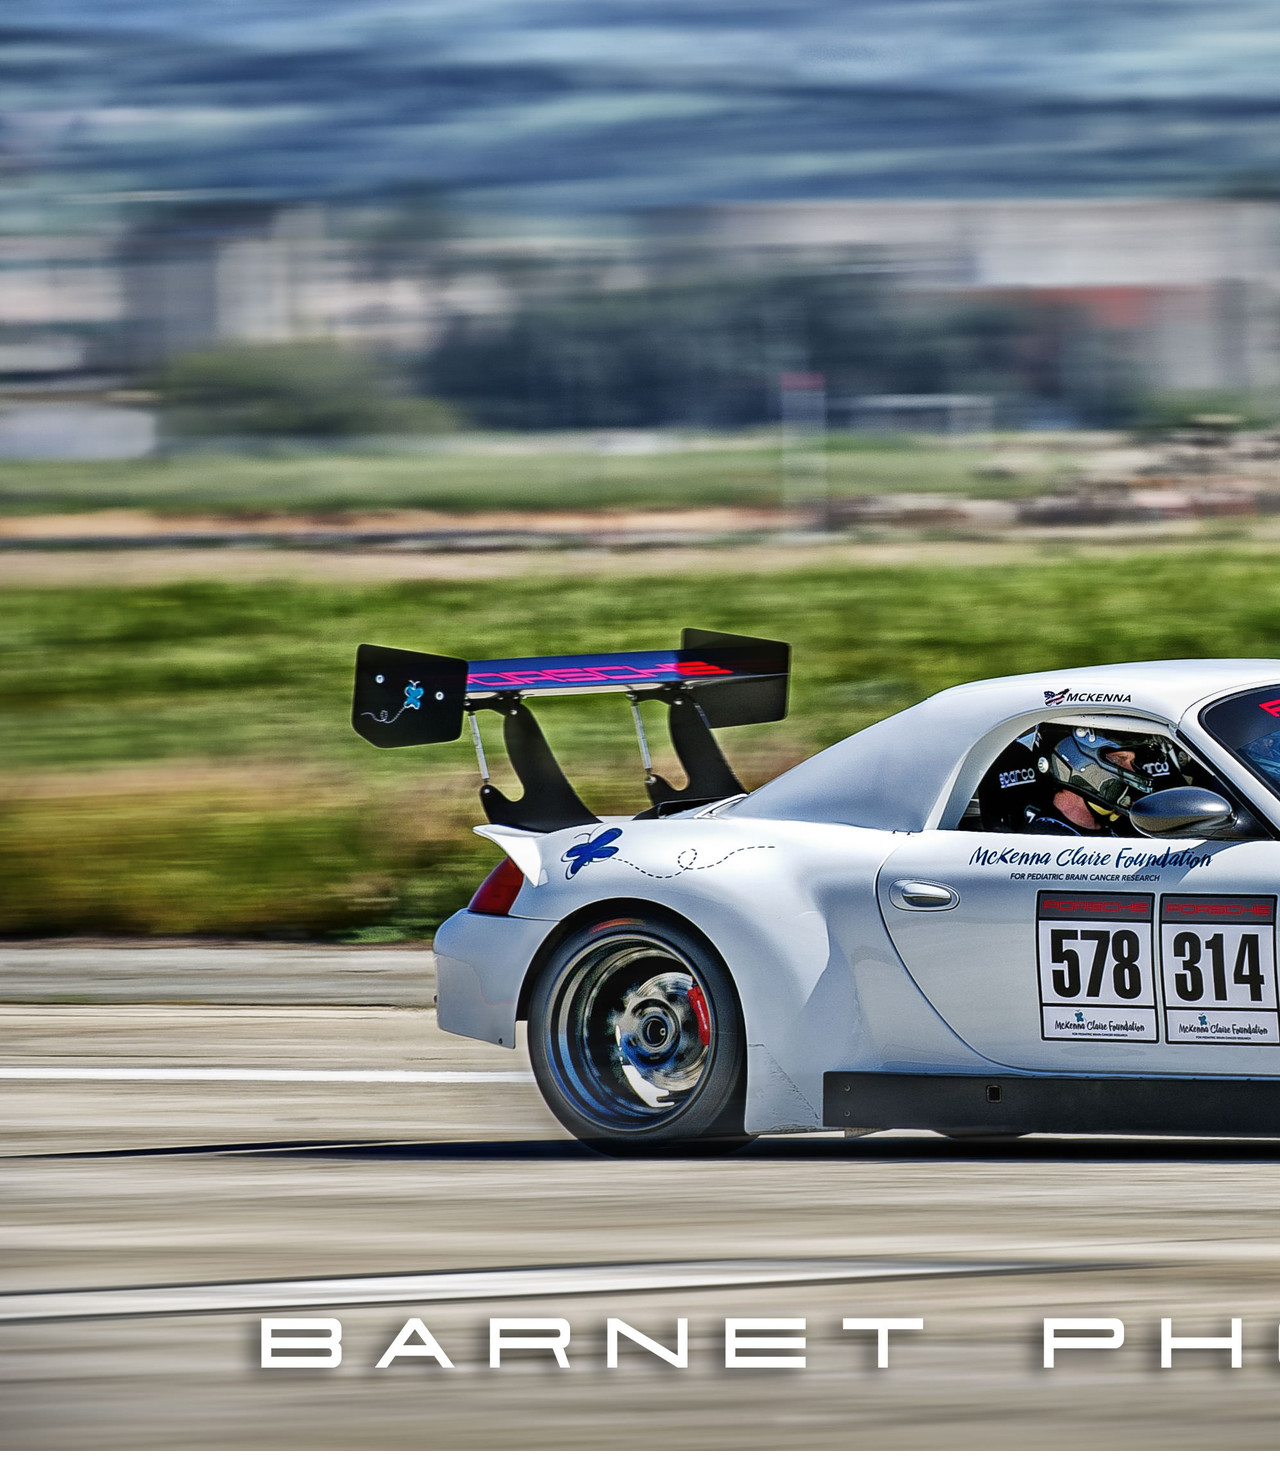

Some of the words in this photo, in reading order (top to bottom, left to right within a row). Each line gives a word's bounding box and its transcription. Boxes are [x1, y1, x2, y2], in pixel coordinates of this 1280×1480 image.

[467, 660, 734, 687] ORSCHE
[1066, 693, 1132, 703] MCKENNA
[969, 846, 1051, 866] McKenna
[1056, 846, 1111, 867] Claire
[1115, 846, 1213, 869] Foundation
[1010, 872, 1026, 880] FOR
[1027, 873, 1064, 881] PEDIATRIC
[1065, 873, 1088, 881] BRAIN
[1089, 874, 1120, 882] CANCER
[1121, 874, 1160, 882] RESEARCH
[1043, 900, 1148, 914] PORSCHE
[1165, 903, 1270, 916] PORSCHE
[1050, 929, 1142, 1000] 578
[1173, 931, 1265, 1002] 314
[1054, 1019, 1086, 1031] McKenna
[1086, 1020, 1107, 1031] Claire
[1108, 1020, 1145, 1032] Foundation
[1179, 1023, 1209, 1034] McKenna
[1210, 1023, 1231, 1034] Claire
[1231, 1023, 1268, 1035] Foundation
